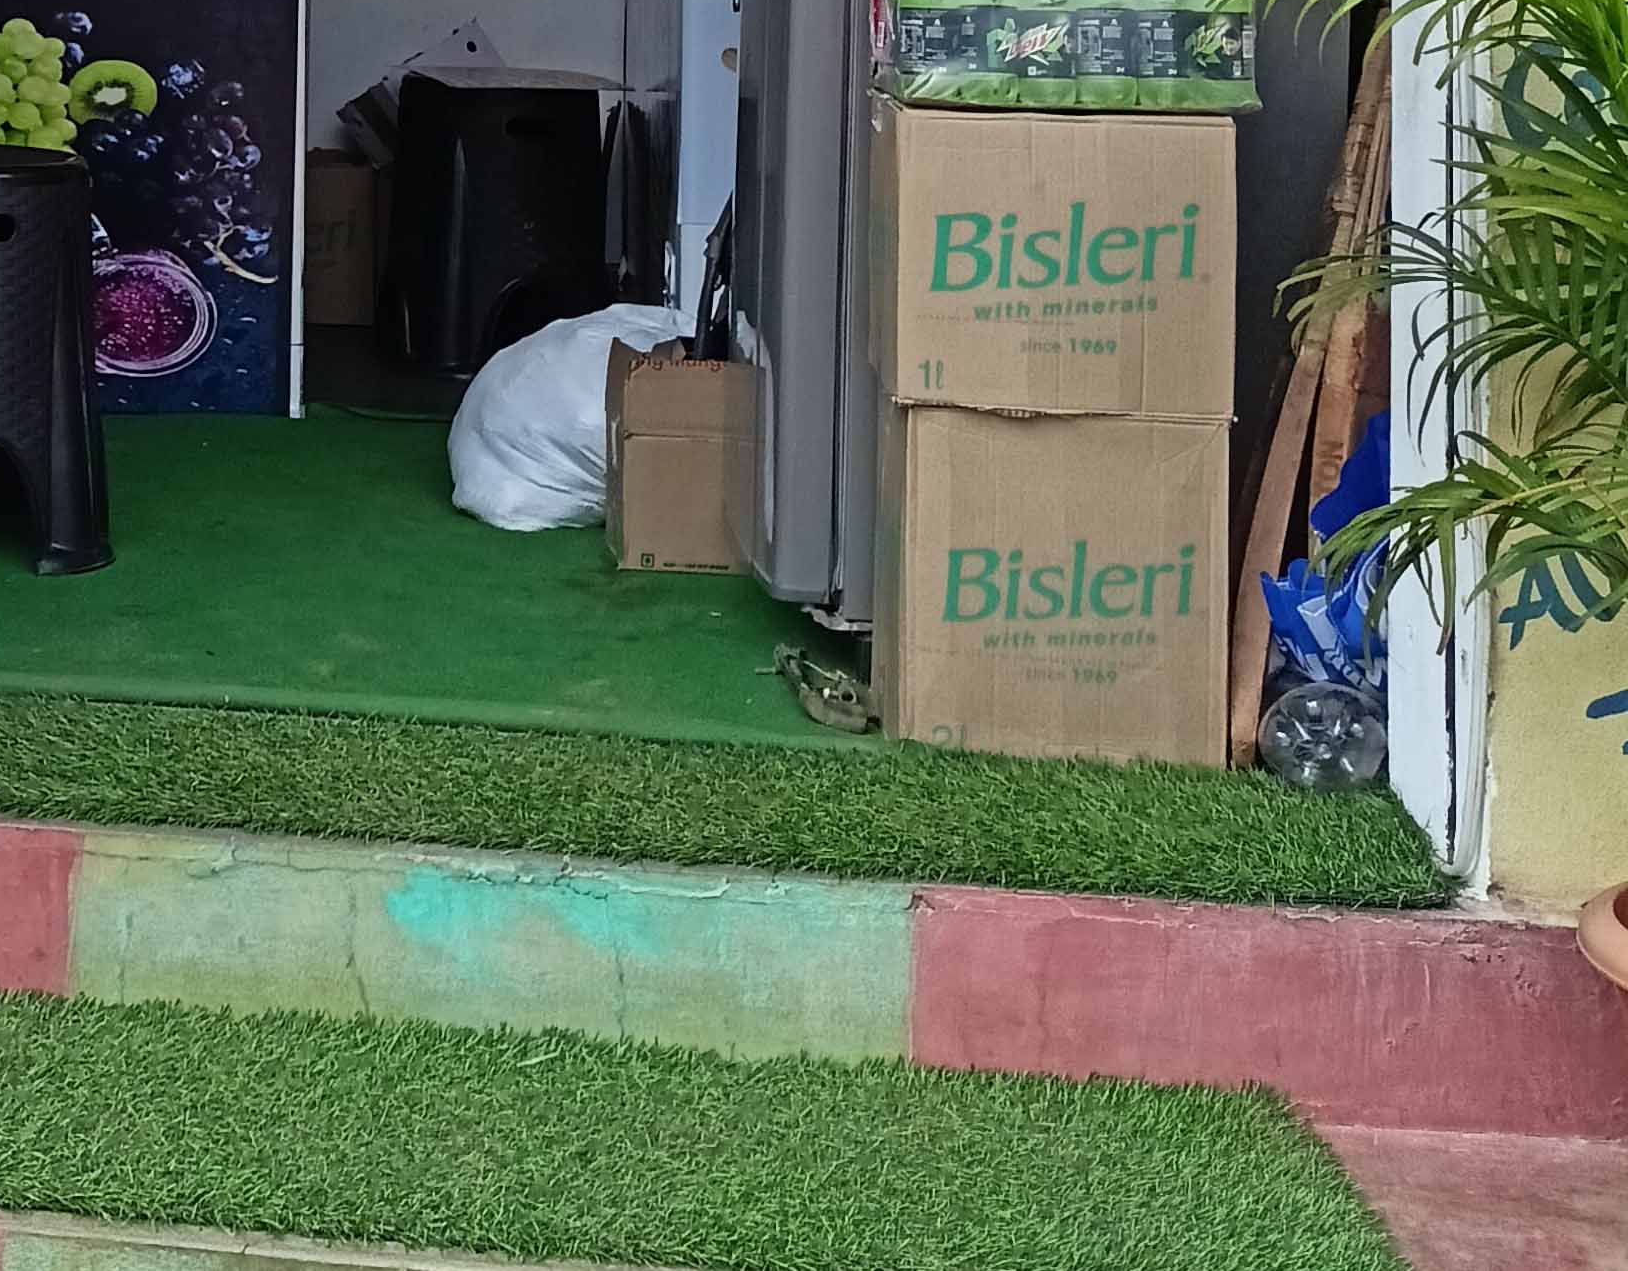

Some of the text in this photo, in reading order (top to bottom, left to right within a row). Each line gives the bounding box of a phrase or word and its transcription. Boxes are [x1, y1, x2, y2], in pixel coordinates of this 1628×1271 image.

[929, 201, 1201, 292] Bisleri
[974, 295, 1158, 322] with minerals
[1020, 337, 1118, 356] since 1969
[942, 539, 1197, 623] Bisleri
[983, 628, 1157, 650] with minerals
[1072, 667, 1119, 685] 1969
